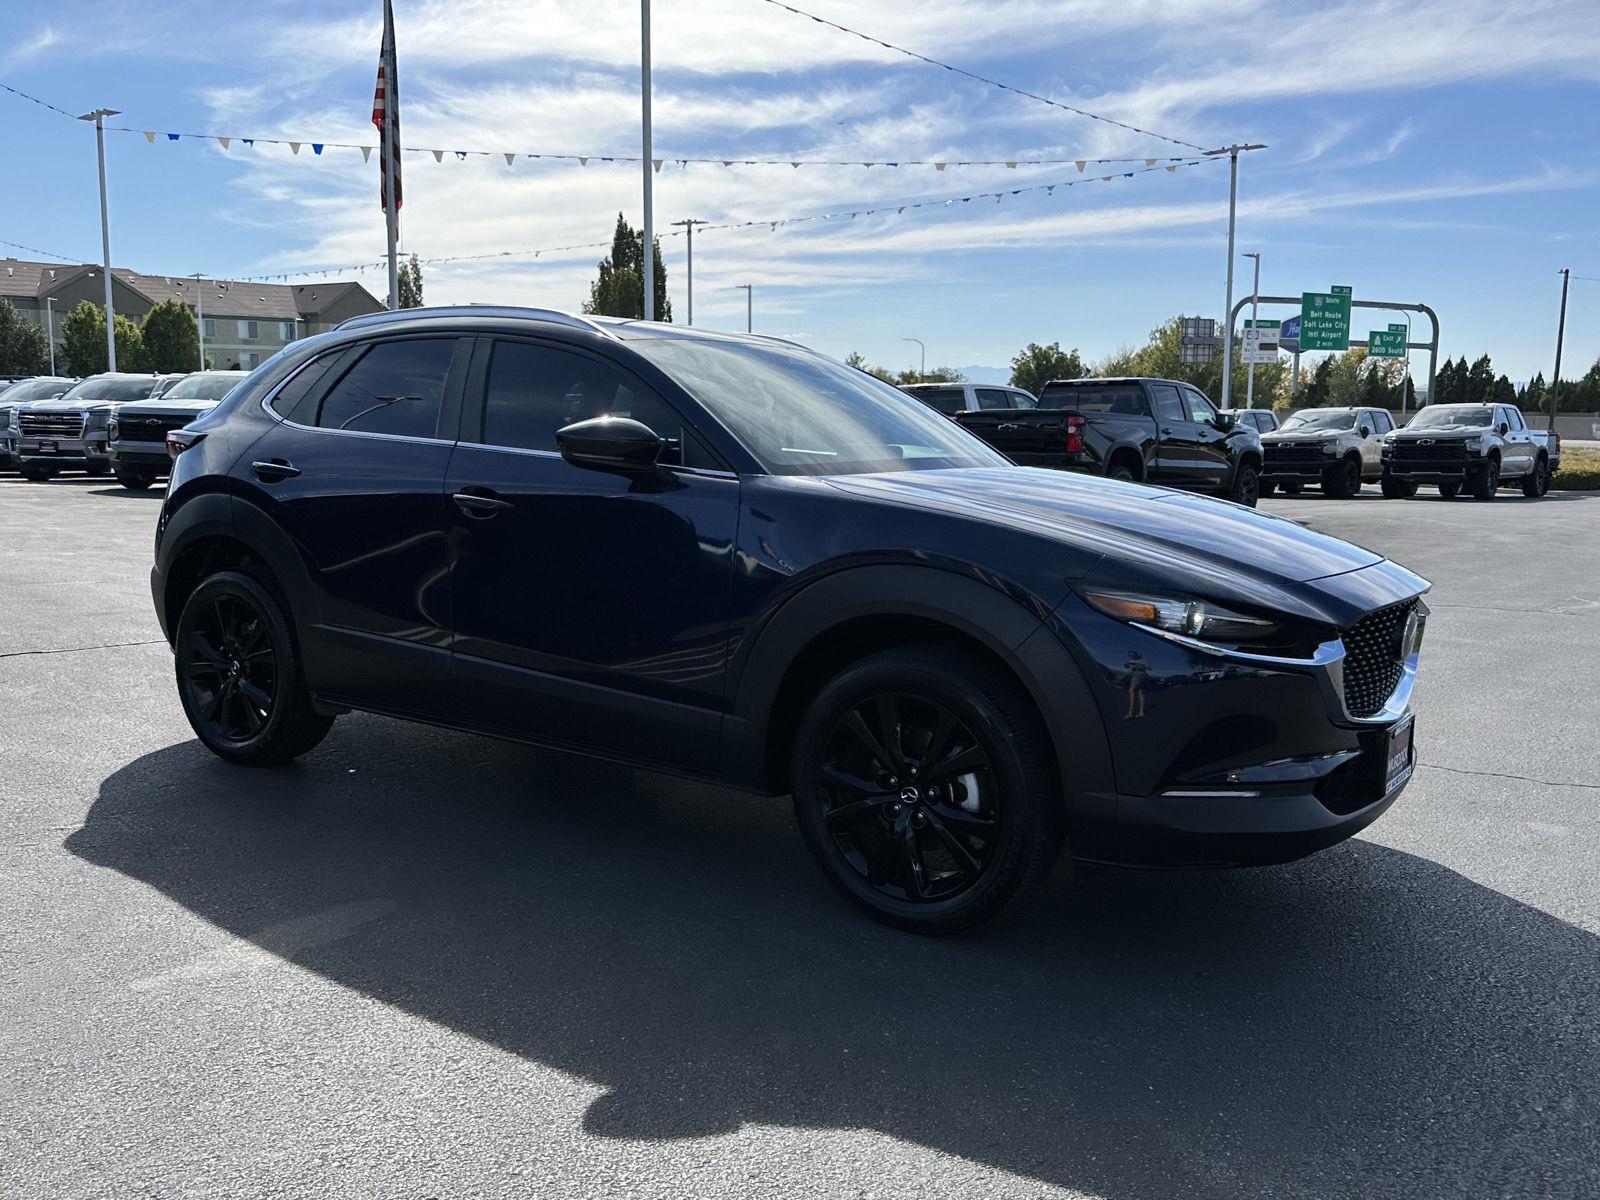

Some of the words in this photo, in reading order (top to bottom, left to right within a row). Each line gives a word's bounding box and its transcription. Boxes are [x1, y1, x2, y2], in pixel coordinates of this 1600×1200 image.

[1310, 310, 1322, 318] Belt
[1325, 311, 1342, 319] Route
[1303, 320, 1316, 328] Salt
[1318, 321, 1332, 329] Lake
[1334, 321, 1347, 330] City
[1321, 331, 1342, 340] Airport
[1371, 346, 1386, 354] 2600
[1388, 347, 1404, 355] South
